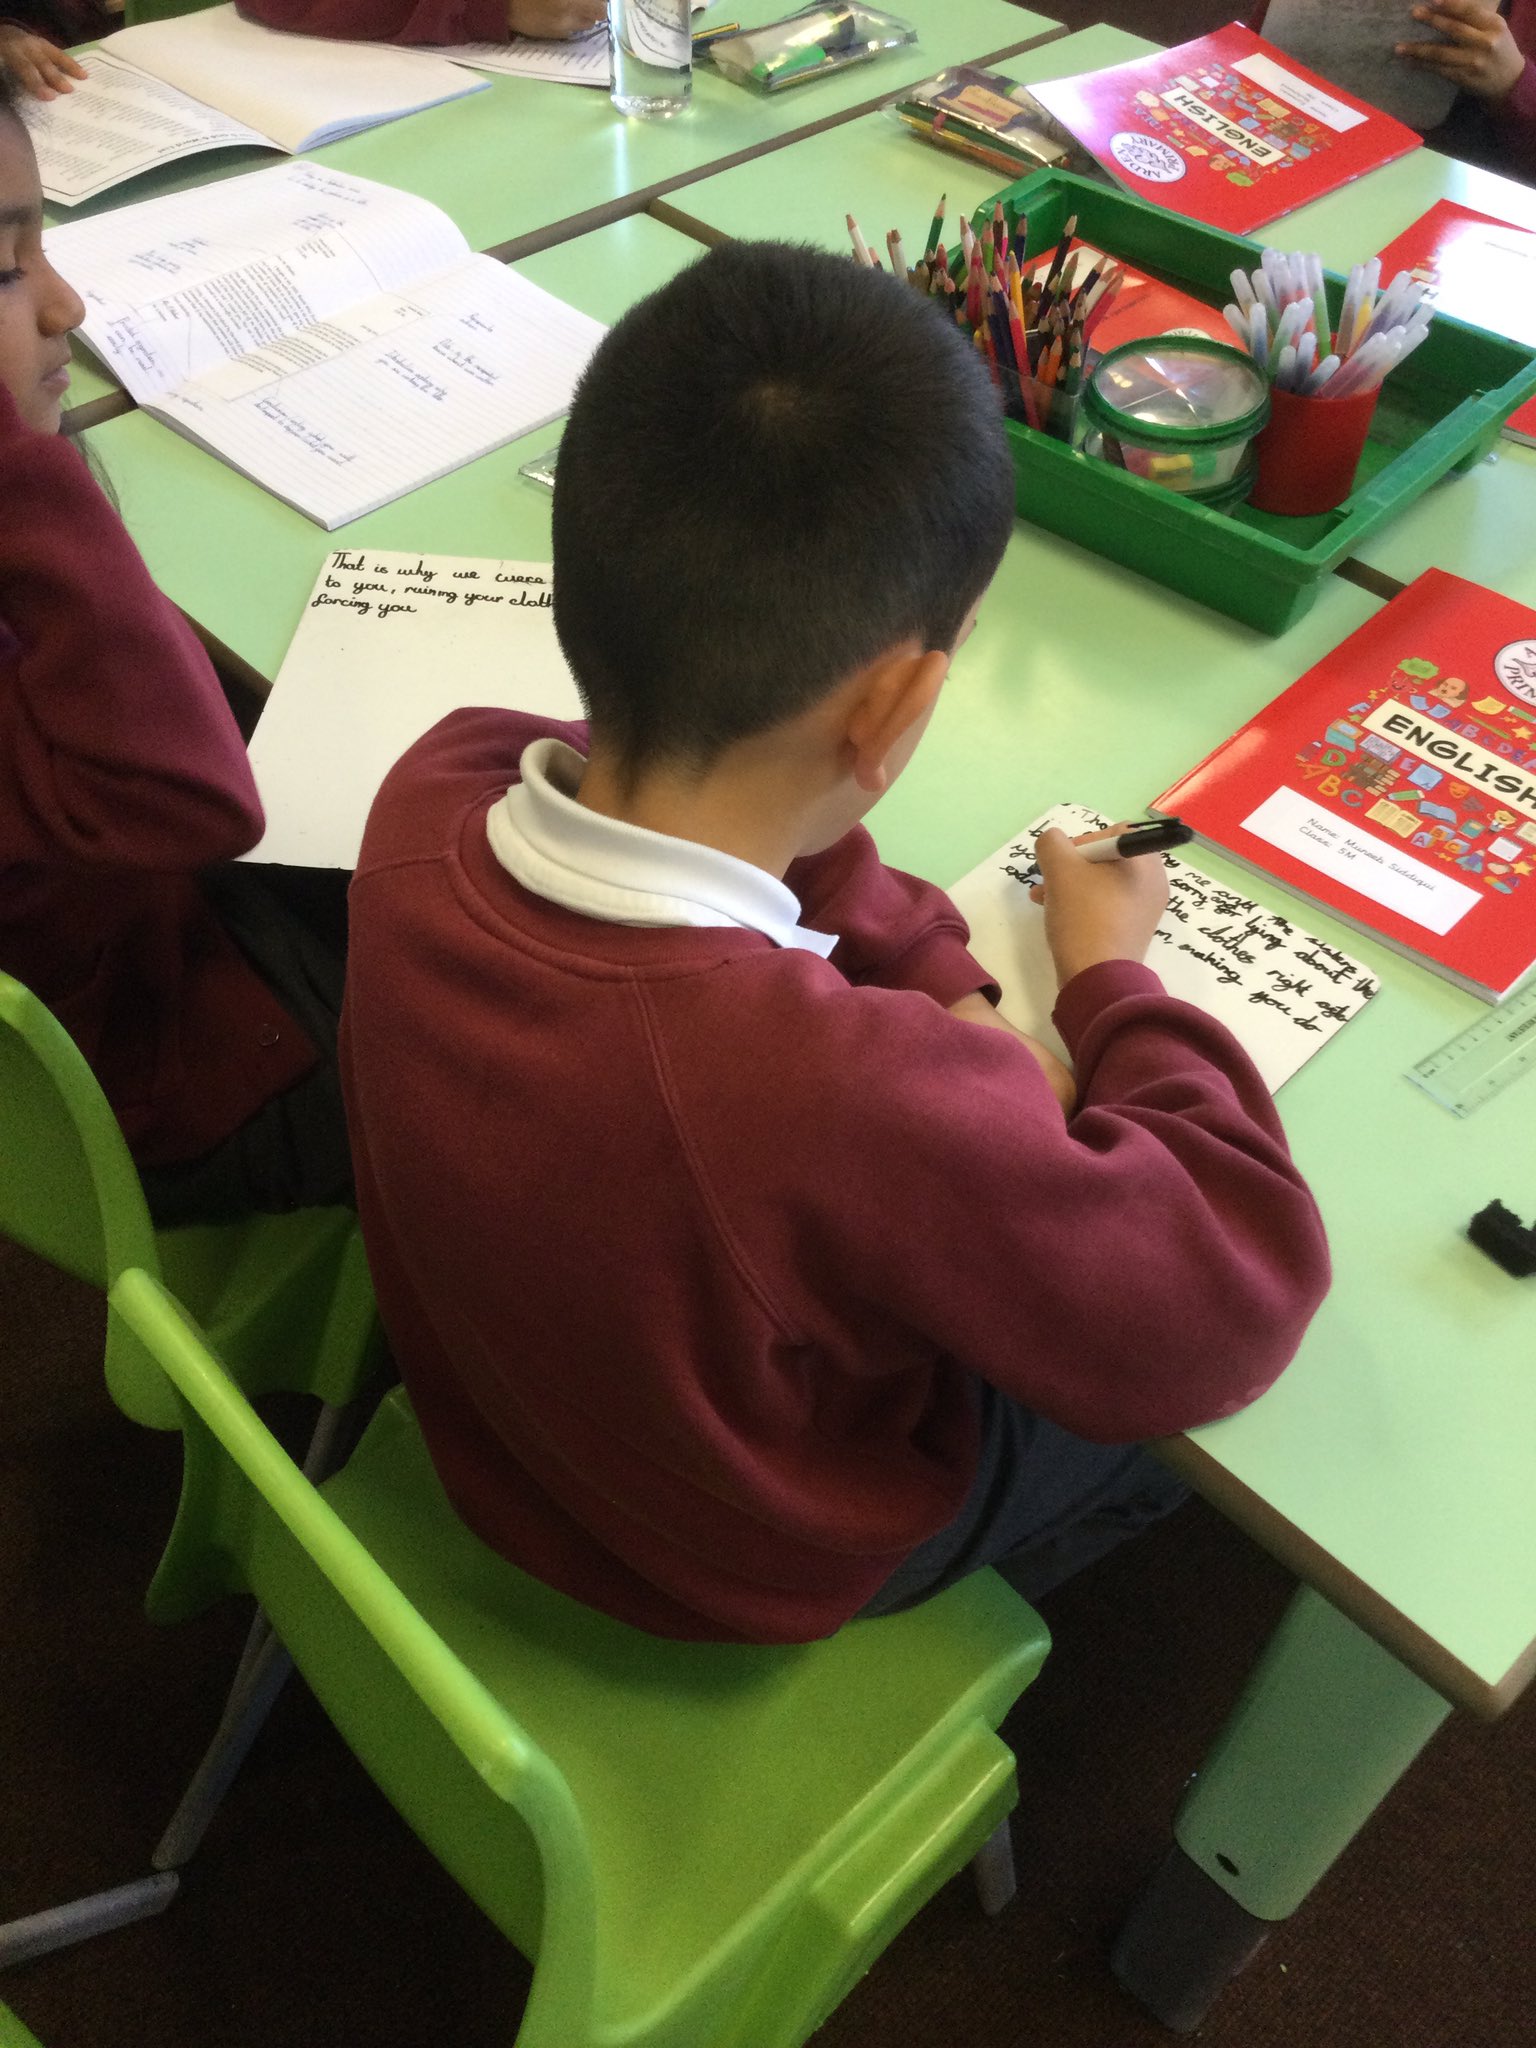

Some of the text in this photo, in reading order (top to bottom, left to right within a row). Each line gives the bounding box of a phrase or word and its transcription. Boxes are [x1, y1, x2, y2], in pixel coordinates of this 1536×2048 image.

[1174, 94, 1272, 158] ENGLISH
[325, 574, 341, 588] to
[464, 592, 504, 606] your
[332, 552, 366, 571] That
[374, 564, 389, 574] is
[397, 560, 438, 583] why
[453, 571, 480, 580] we
[311, 593, 418, 619] forcing you
[1382, 713, 1536, 810] ENGLISH
[1299, 826, 1358, 861] Class: 5M
[1307, 817, 1340, 840] Name:
[1388, 862, 1437, 892] Siddiqui
[1185, 872, 1212, 887] me
[1165, 895, 1190, 923] the
[1197, 925, 1257, 964] clothes
[1265, 969, 1314, 998] right
[1169, 878, 1209, 910] sorry,
[1245, 915, 1287, 951] lying
[1293, 949, 1353, 985] about
[1352, 978, 1376, 1000] the
[1177, 943, 1243, 986] making
[1248, 991, 1292, 1016] you
[1293, 1015, 1323, 1033] do
